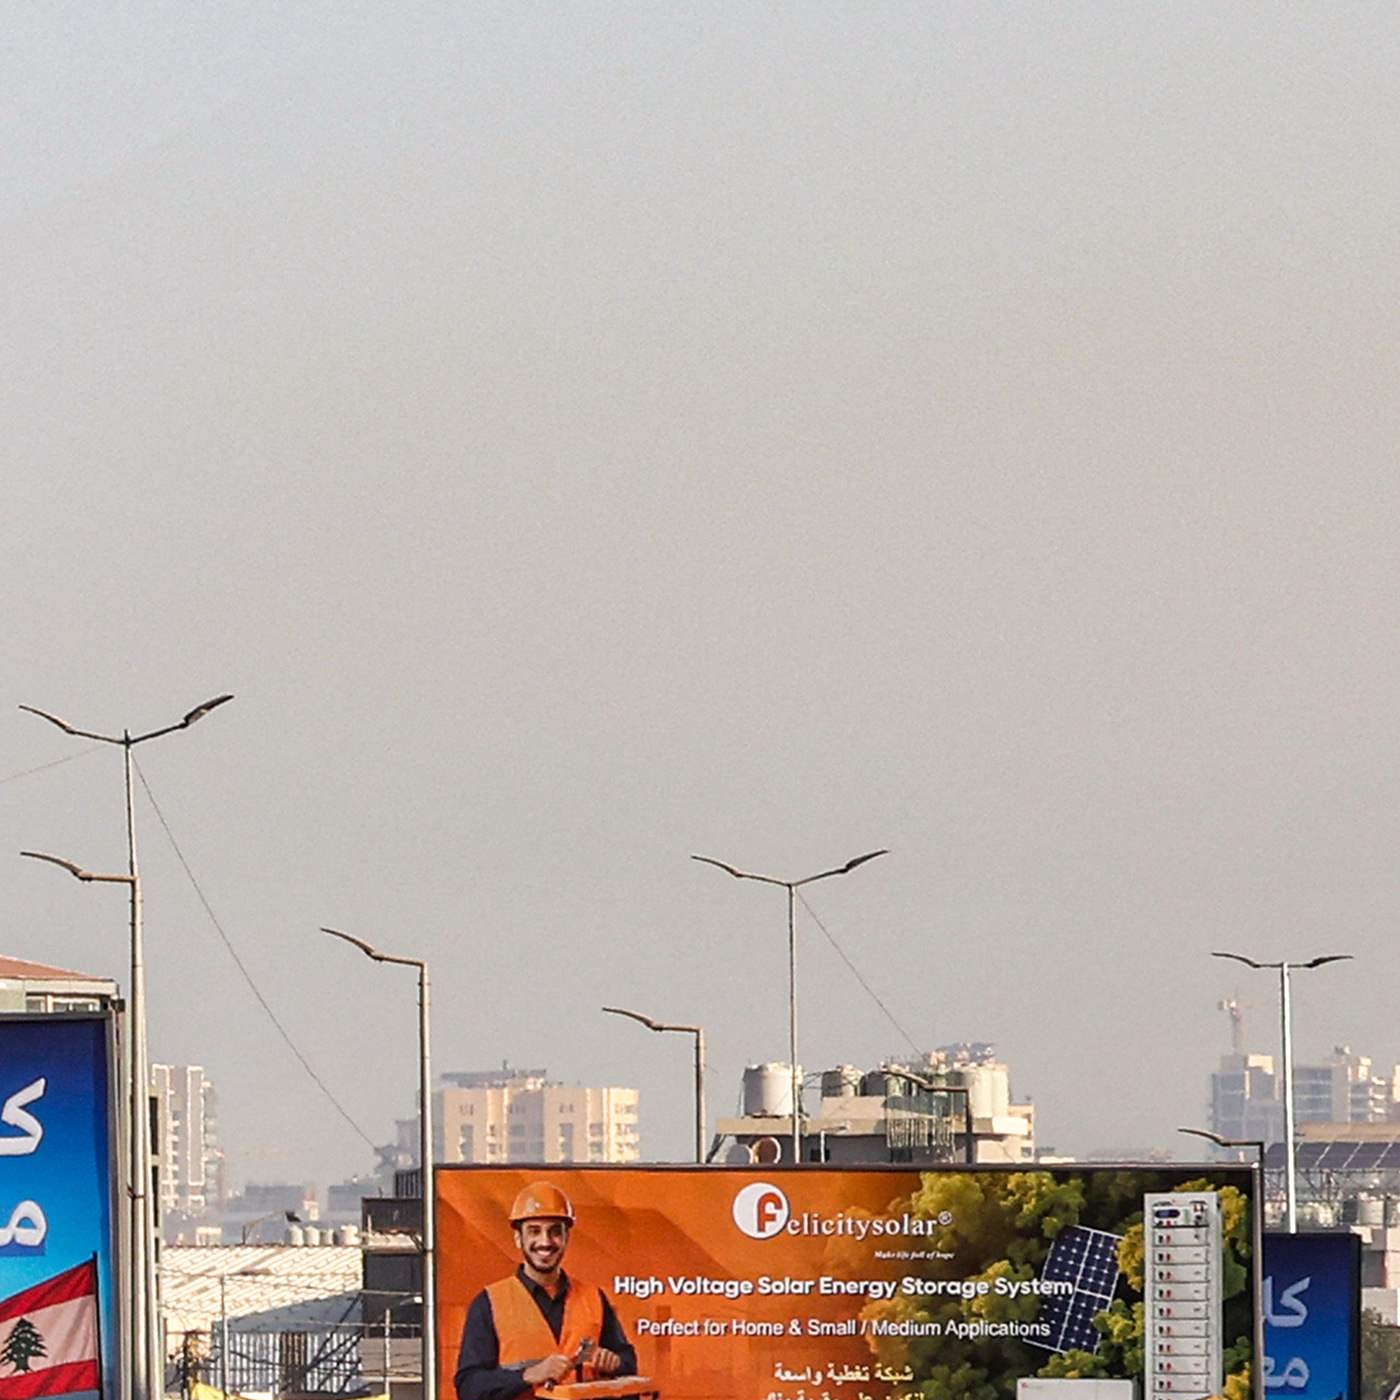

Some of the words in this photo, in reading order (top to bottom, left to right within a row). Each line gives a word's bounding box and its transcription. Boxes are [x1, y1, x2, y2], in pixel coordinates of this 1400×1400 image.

[614, 1276, 663, 1298] High
[668, 1276, 753, 1298] Voltage
[758, 1276, 814, 1294] Solar
[820, 1277, 896, 1298] Energy
[902, 1277, 989, 1298] Storage
[995, 1277, 1073, 1298] System
[637, 1319, 699, 1336] Perfect
[703, 1319, 727, 1336] for
[732, 1319, 784, 1336] Home
[788, 1319, 802, 1336] &
[808, 1319, 856, 1336] Small
[872, 1320, 941, 1336] Medium
[945, 1320, 1050, 1339] Applications
[774, 1363, 823, 1385] واسعة
[827, 1363, 870, 1385] تغطية
[875, 1363, 914, 1384] شبكة
